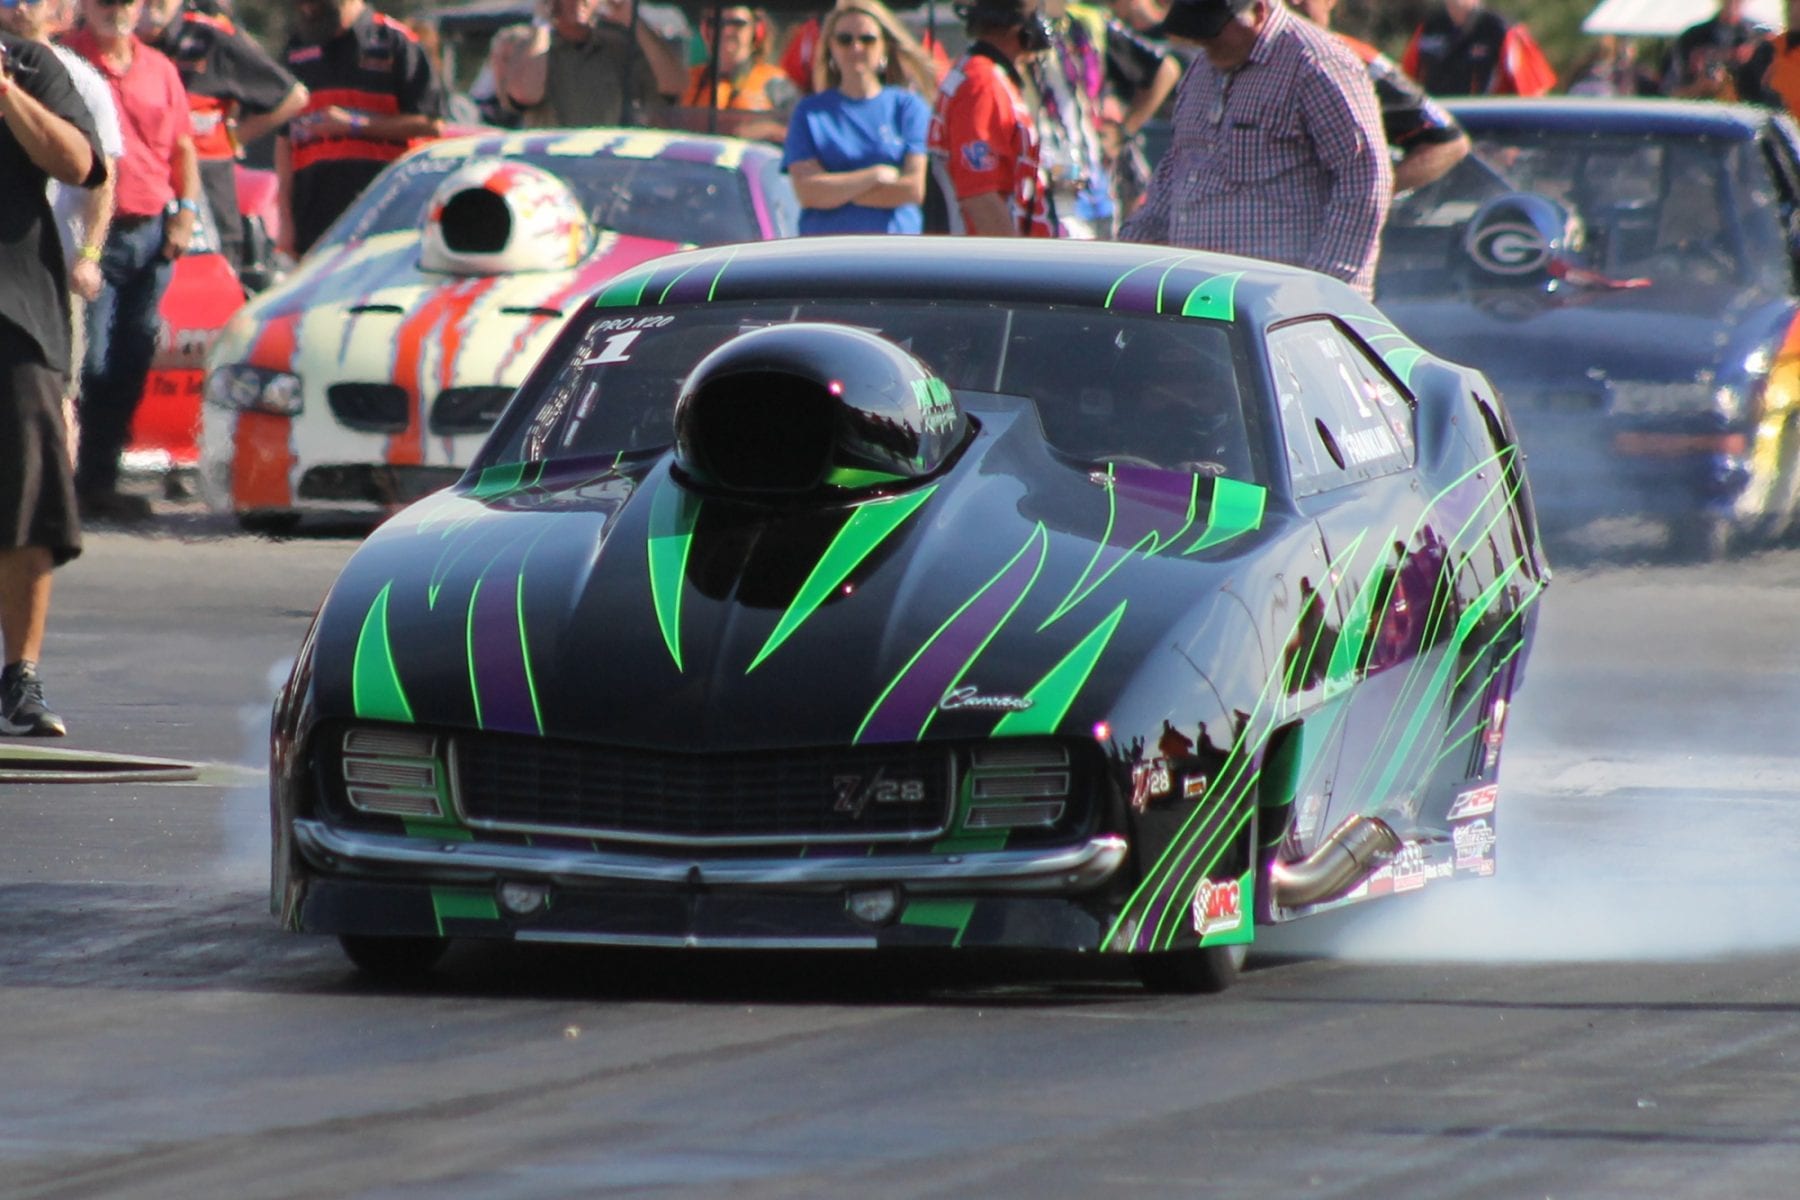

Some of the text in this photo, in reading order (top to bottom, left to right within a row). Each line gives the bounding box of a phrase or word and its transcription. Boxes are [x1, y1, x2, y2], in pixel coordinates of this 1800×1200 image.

[592, 317, 634, 333] PRO
[584, 330, 641, 365] 1
[833, 766, 924, 819] Z/28
